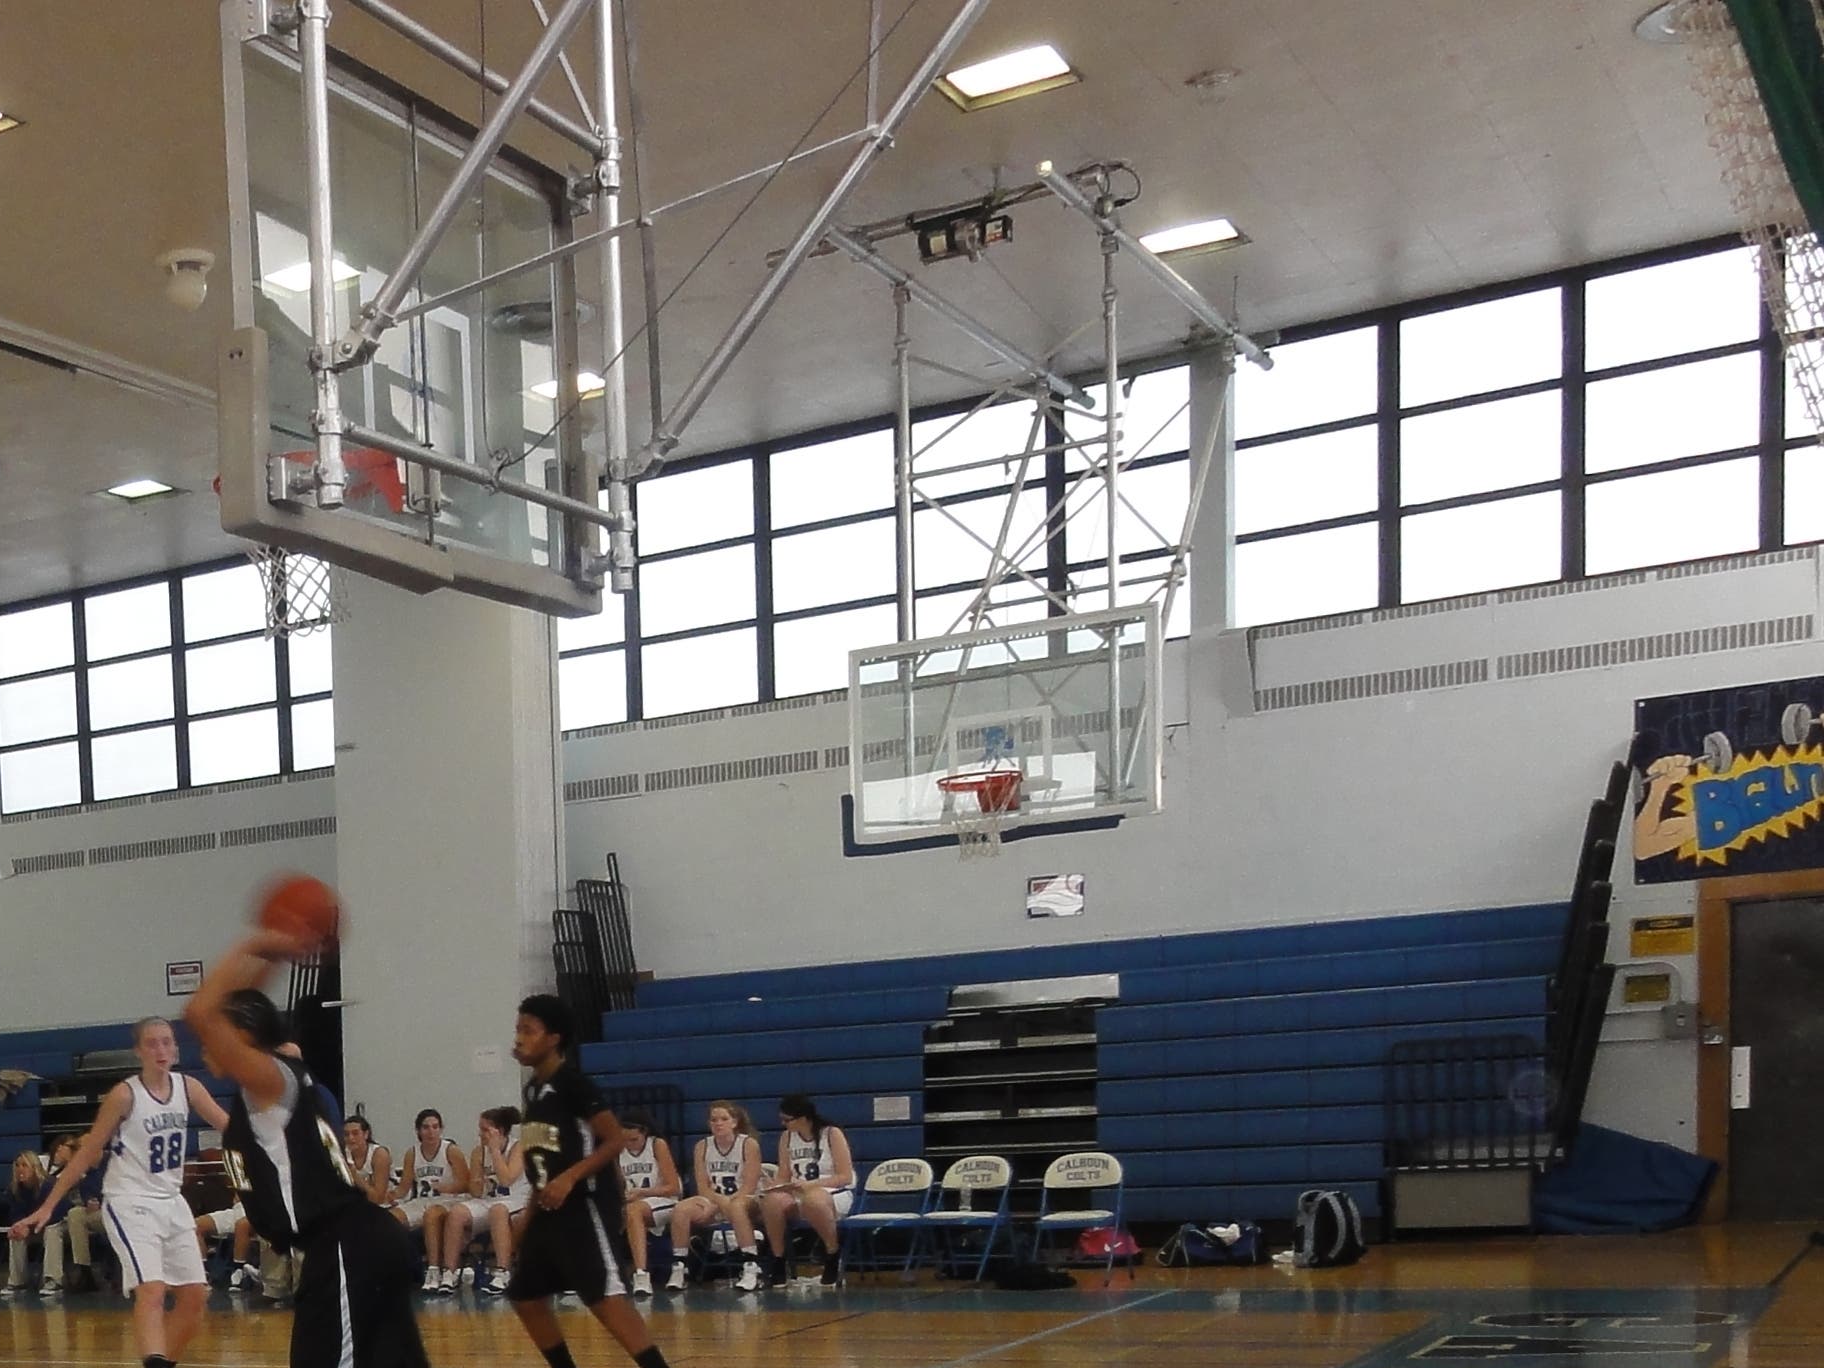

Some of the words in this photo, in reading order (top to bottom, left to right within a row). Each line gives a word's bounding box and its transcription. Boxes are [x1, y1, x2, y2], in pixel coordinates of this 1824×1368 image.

[150, 1132, 182, 1173] 88
[1056, 1158, 1110, 1172] CALHOUN
[1066, 1170, 1101, 1180] COLTS
